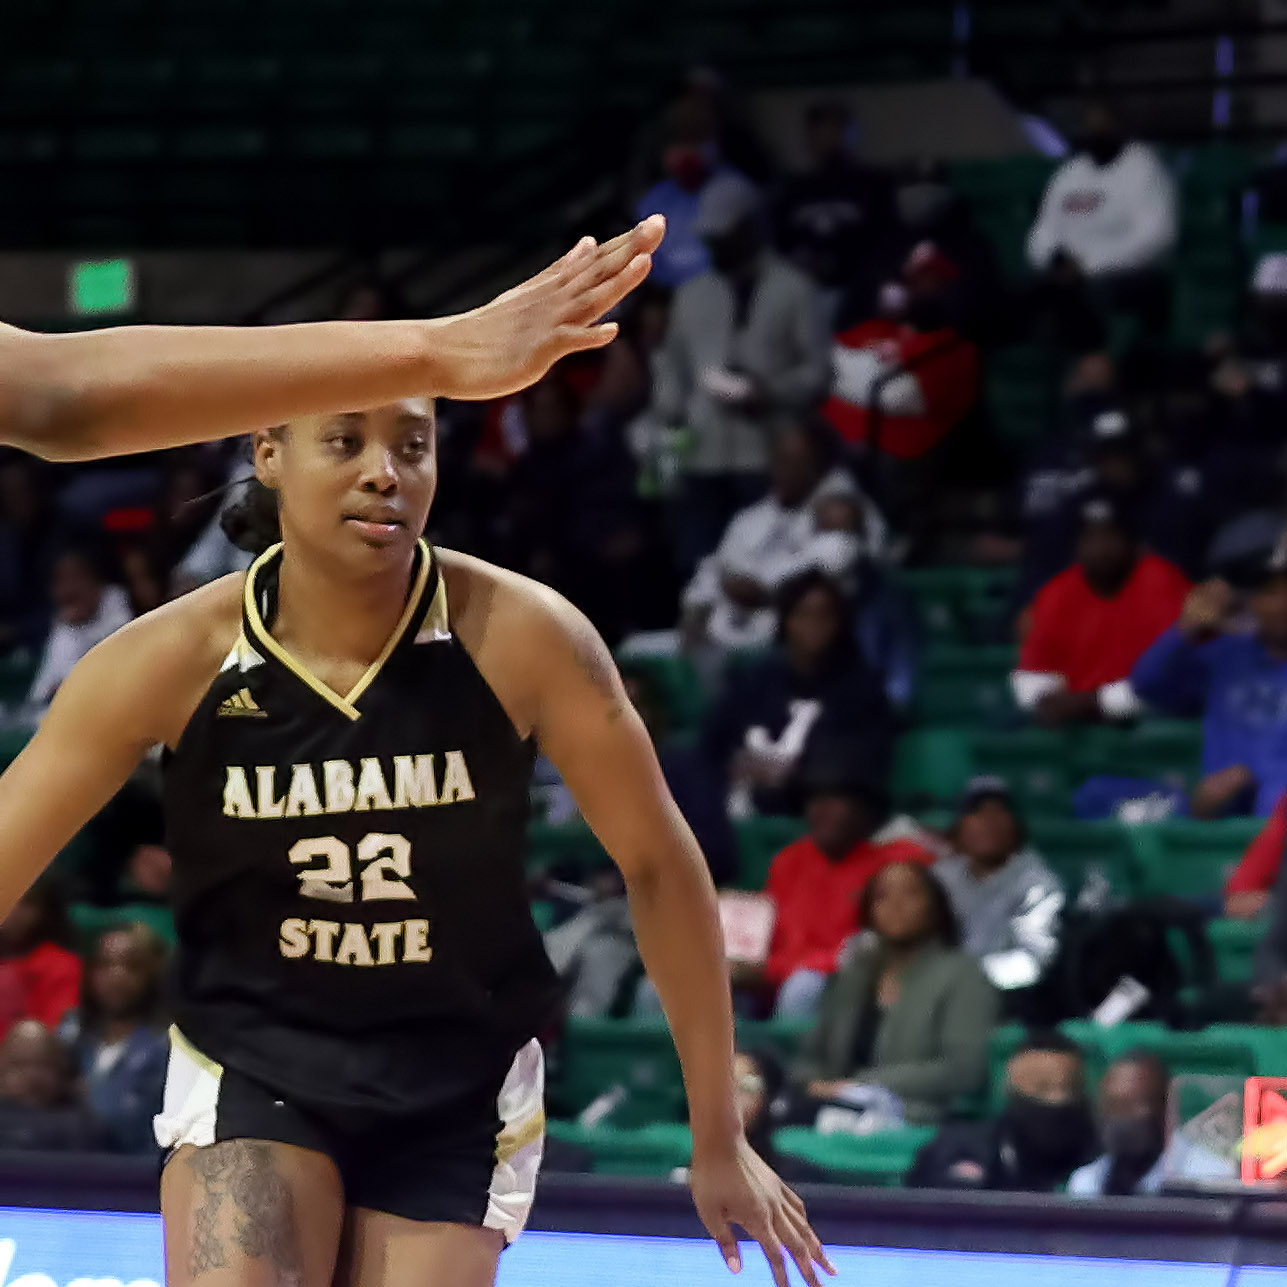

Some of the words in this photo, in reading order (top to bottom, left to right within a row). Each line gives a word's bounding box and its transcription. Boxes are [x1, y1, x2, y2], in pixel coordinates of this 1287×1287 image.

[222, 749, 476, 820] ALABAMA
[287, 831, 419, 903] 22
[279, 917, 434, 967] STATE
